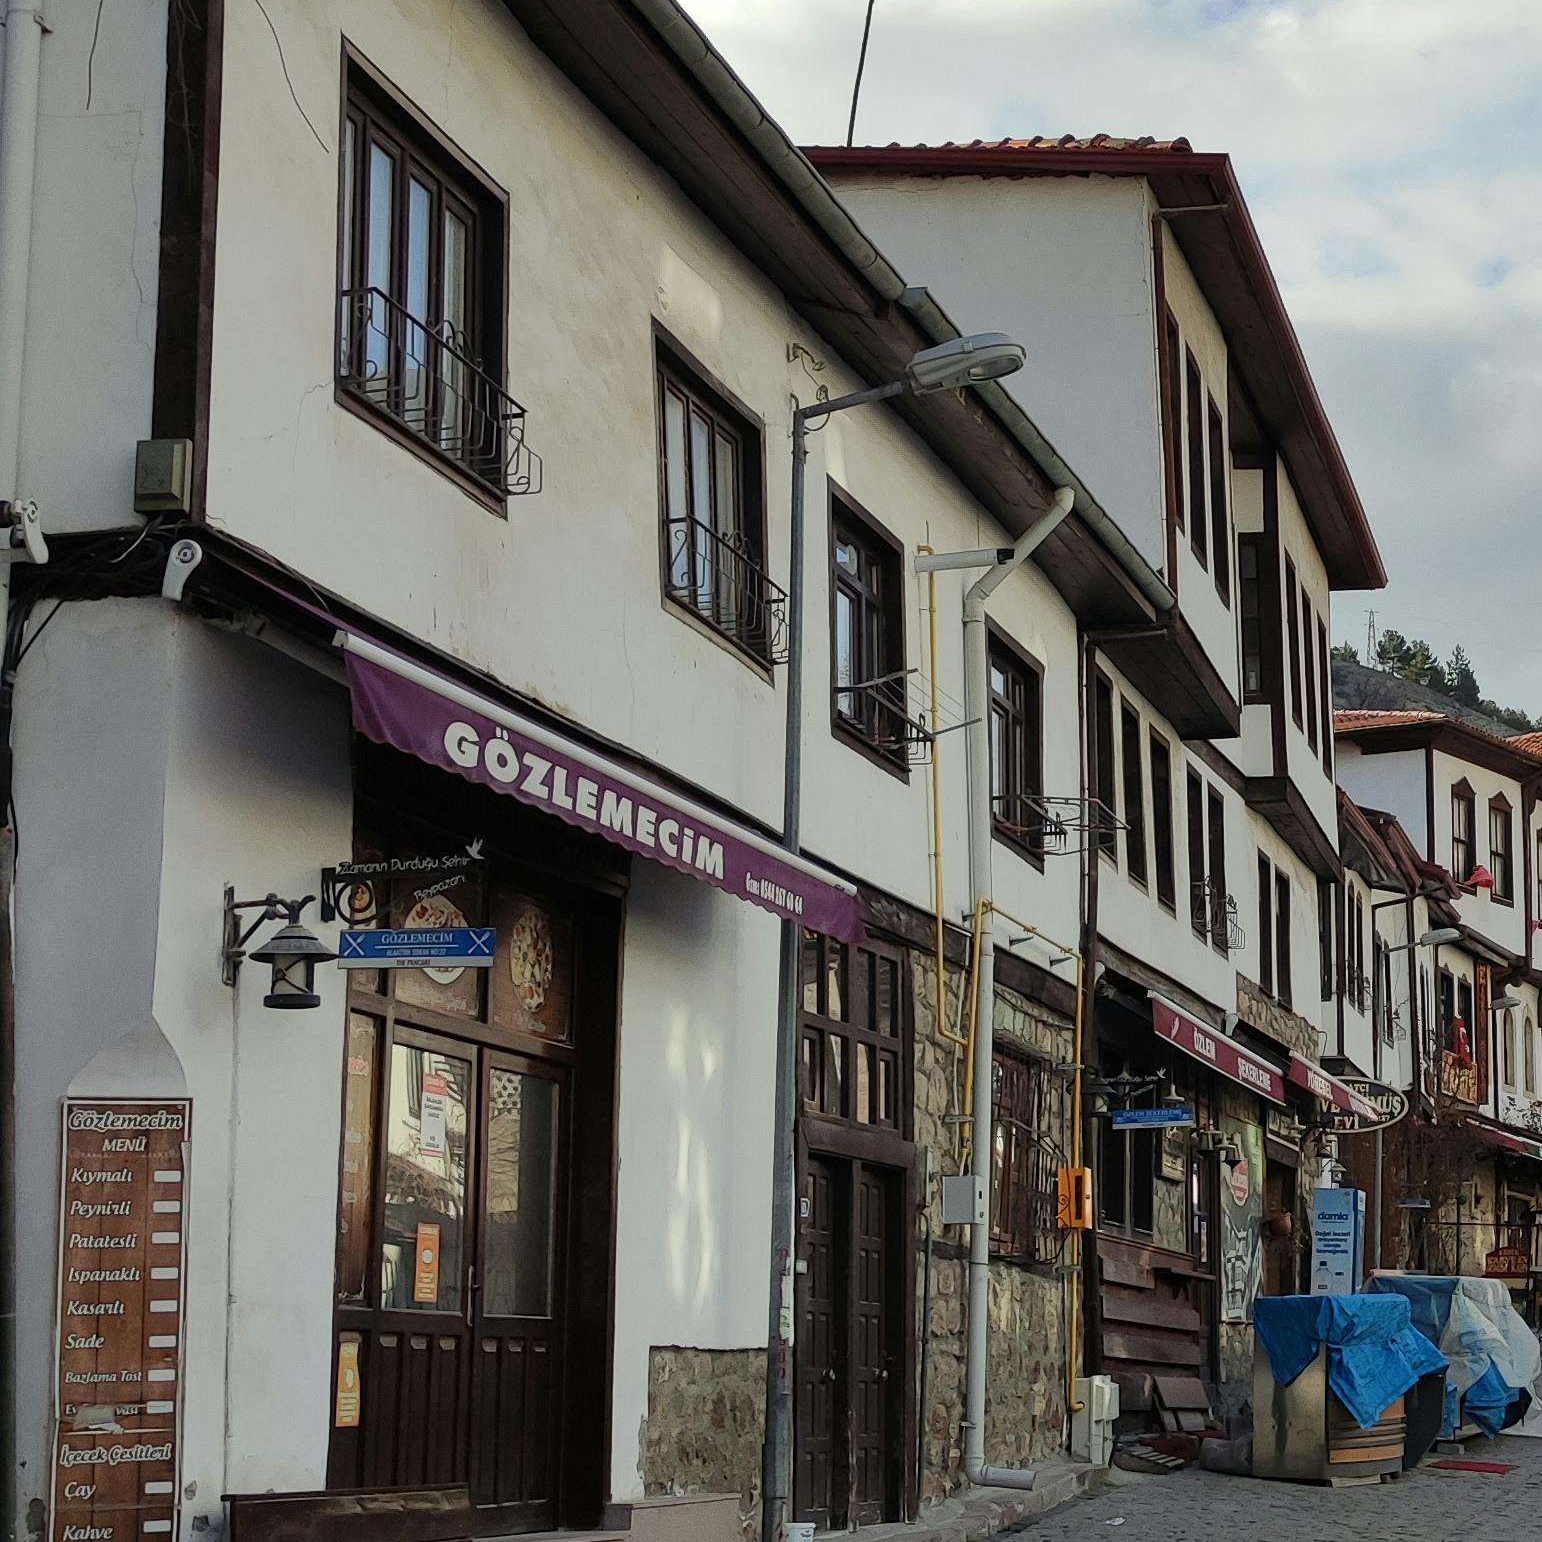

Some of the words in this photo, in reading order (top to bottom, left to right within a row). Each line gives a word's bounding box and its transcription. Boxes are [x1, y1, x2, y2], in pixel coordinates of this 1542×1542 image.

[443, 721, 725, 881] GÖZLEMECİM
[381, 932, 453, 944] GÖZLEMECİM
[69, 1110, 184, 1133] Gözlemecim
[102, 1136, 147, 1152] MENÜ
[71, 1168, 133, 1185] Kıymalı
[70, 1200, 132, 1218] Peynirli
[1317, 1211, 1349, 1221] damla
[69, 1233, 138, 1249] Patatesli
[68, 1267, 141, 1284] Ispanaklı
[65, 1334, 105, 1349] Sade
[65, 1371, 117, 1384] Bazlama
[120, 1369, 142, 1382] Tost
[64, 1481, 96, 1501] Çay
[63, 1525, 113, 1542] Kahve
